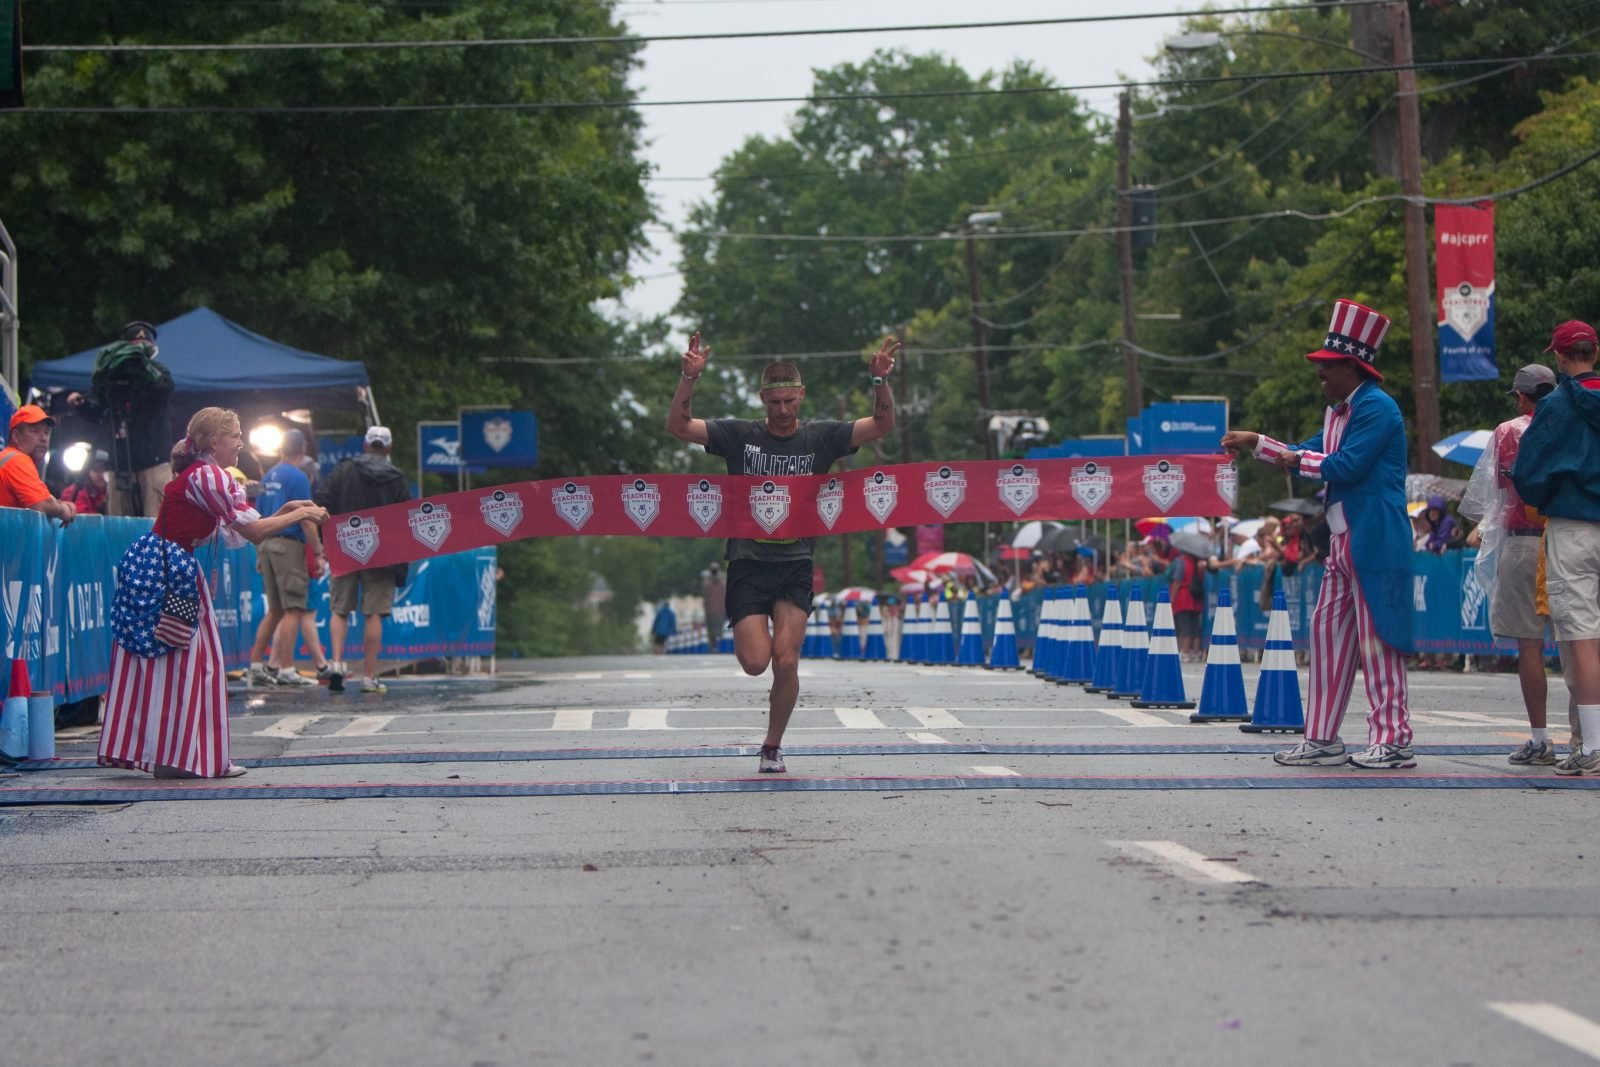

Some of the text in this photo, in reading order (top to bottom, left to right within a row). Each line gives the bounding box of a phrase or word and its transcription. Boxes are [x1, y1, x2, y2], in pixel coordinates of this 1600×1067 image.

[1441, 231, 1489, 247] #ajcprr
[745, 443, 760, 452] TEAM
[744, 450, 815, 476] MILITARY
[925, 480, 966, 489] PEACHTREE
[1070, 476, 1112, 484] PEACHTREE
[864, 485, 898, 495] PEACHTREE
[553, 494, 593, 502] PEACHTREE
[817, 491, 843, 500] PEACHTREE
[481, 501, 522, 511] PEACHTREE
[409, 512, 450, 525] PEACHTREE
[337, 526, 378, 539] PEACHTREE
